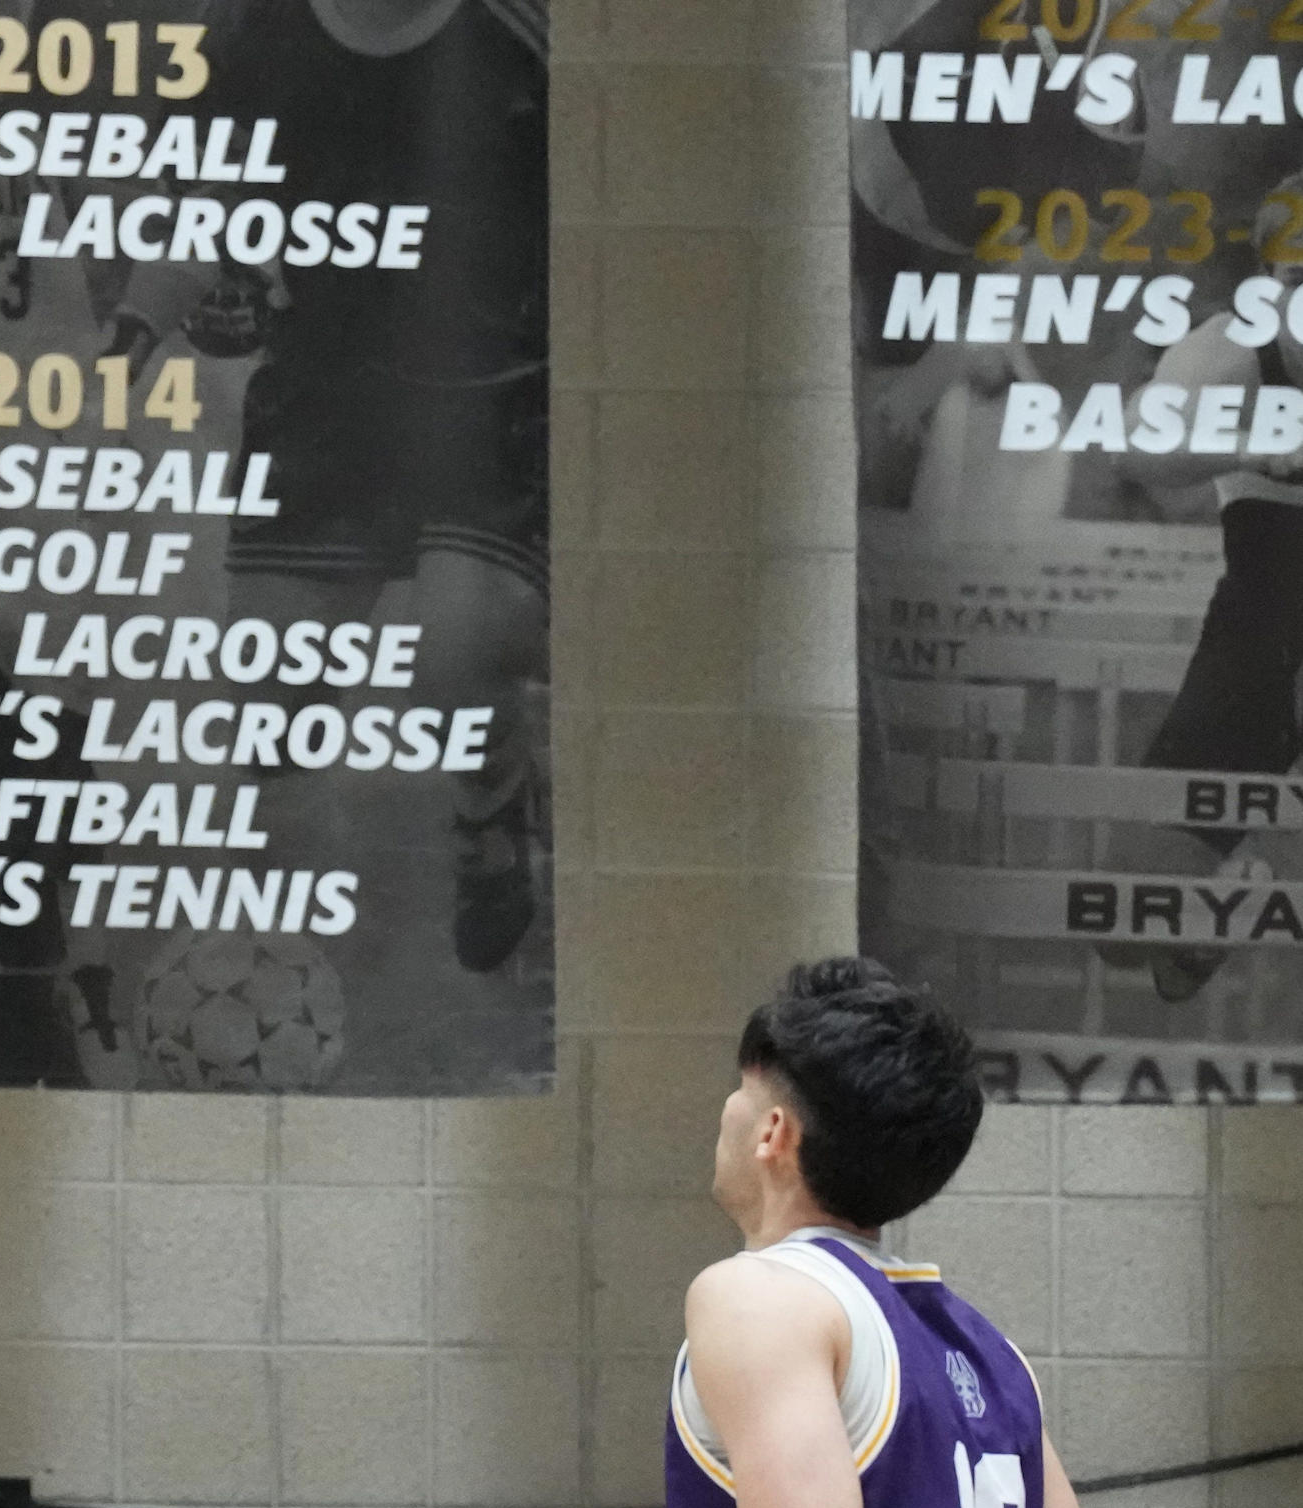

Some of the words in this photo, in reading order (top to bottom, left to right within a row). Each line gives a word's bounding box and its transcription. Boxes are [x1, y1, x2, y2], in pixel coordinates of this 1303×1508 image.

[850, 50, 1137, 125] MEN'S
[1172, 55, 1303, 125] LA
[17, 193, 429, 269] LACROSSE
[883, 273, 1194, 346] MEN'S
[998, 381, 1303, 455] BASEB
[14, 613, 422, 687] LACROSSE
[80, 698, 493, 772] LACROSSE
[69, 865, 358, 935] TENNIS
